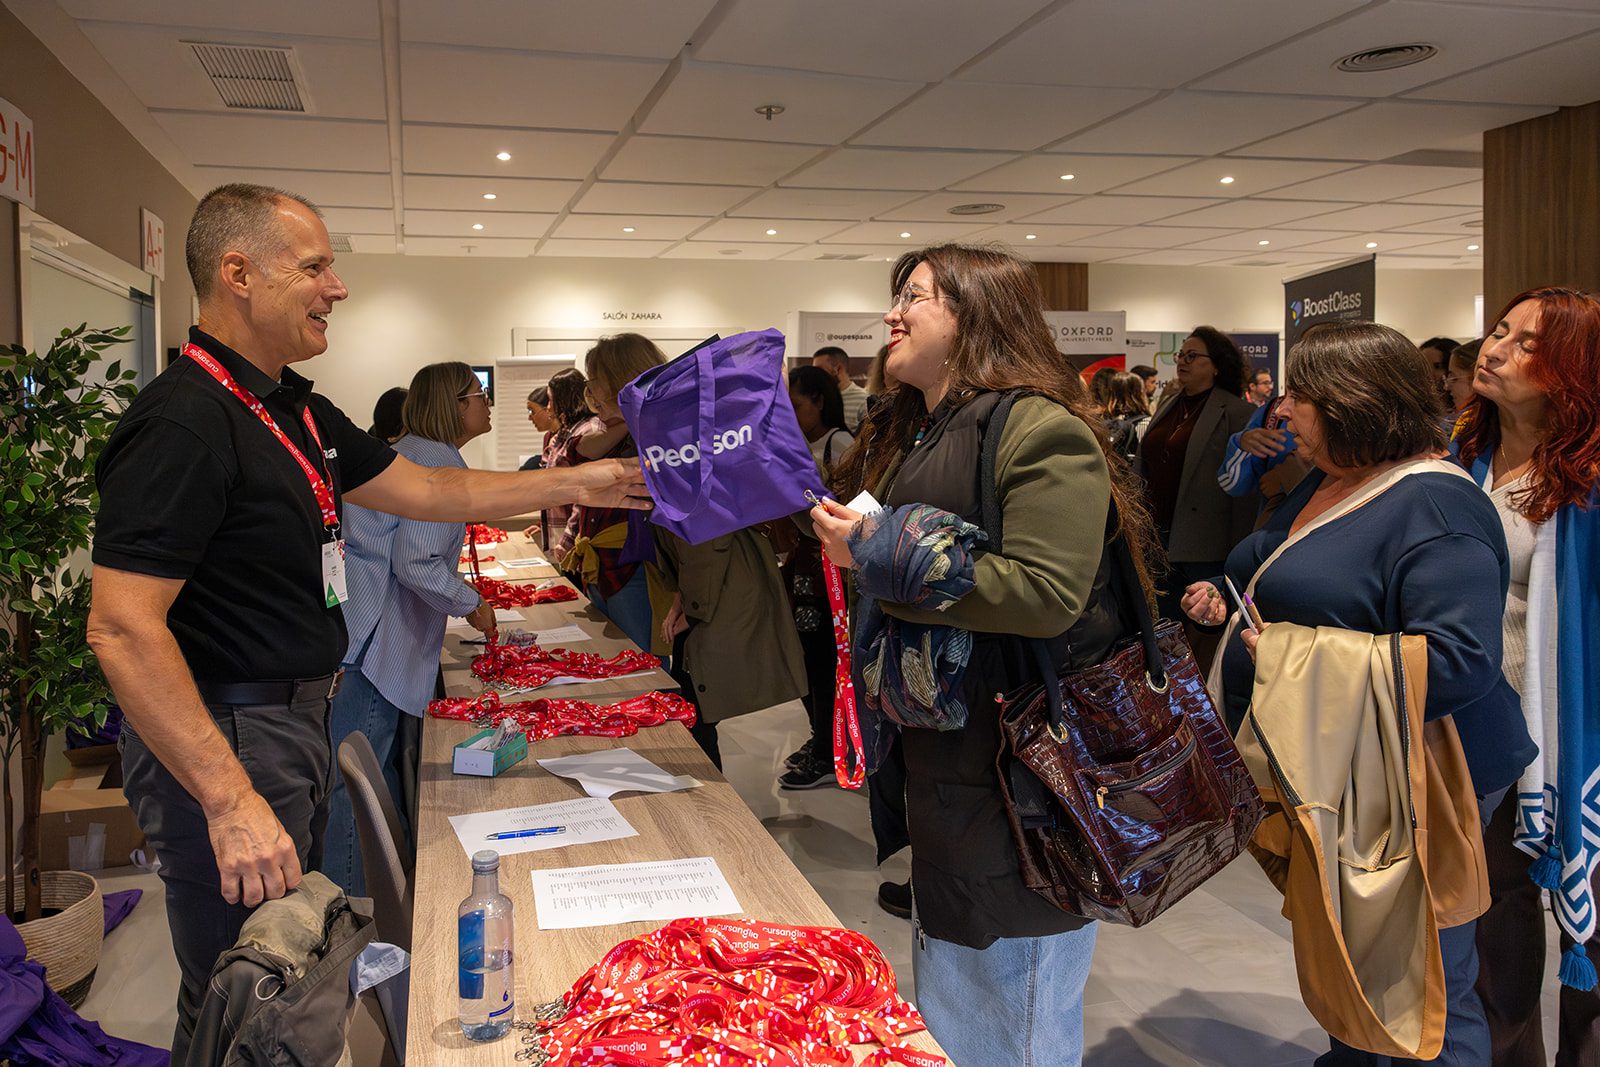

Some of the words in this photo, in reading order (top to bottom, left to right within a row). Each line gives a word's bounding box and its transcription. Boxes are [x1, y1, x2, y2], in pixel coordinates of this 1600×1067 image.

[1303, 290, 1361, 317] BoostClass
[602, 310, 628, 320] SALÓN
[631, 312, 662, 320] ZAHARA
[1061, 327, 1113, 336] OXFORD
[827, 333, 872, 341] @oupespana
[1240, 345, 1268, 353] FORD
[645, 425, 752, 473] Peason
[848, 697, 859, 738] cursanglia
